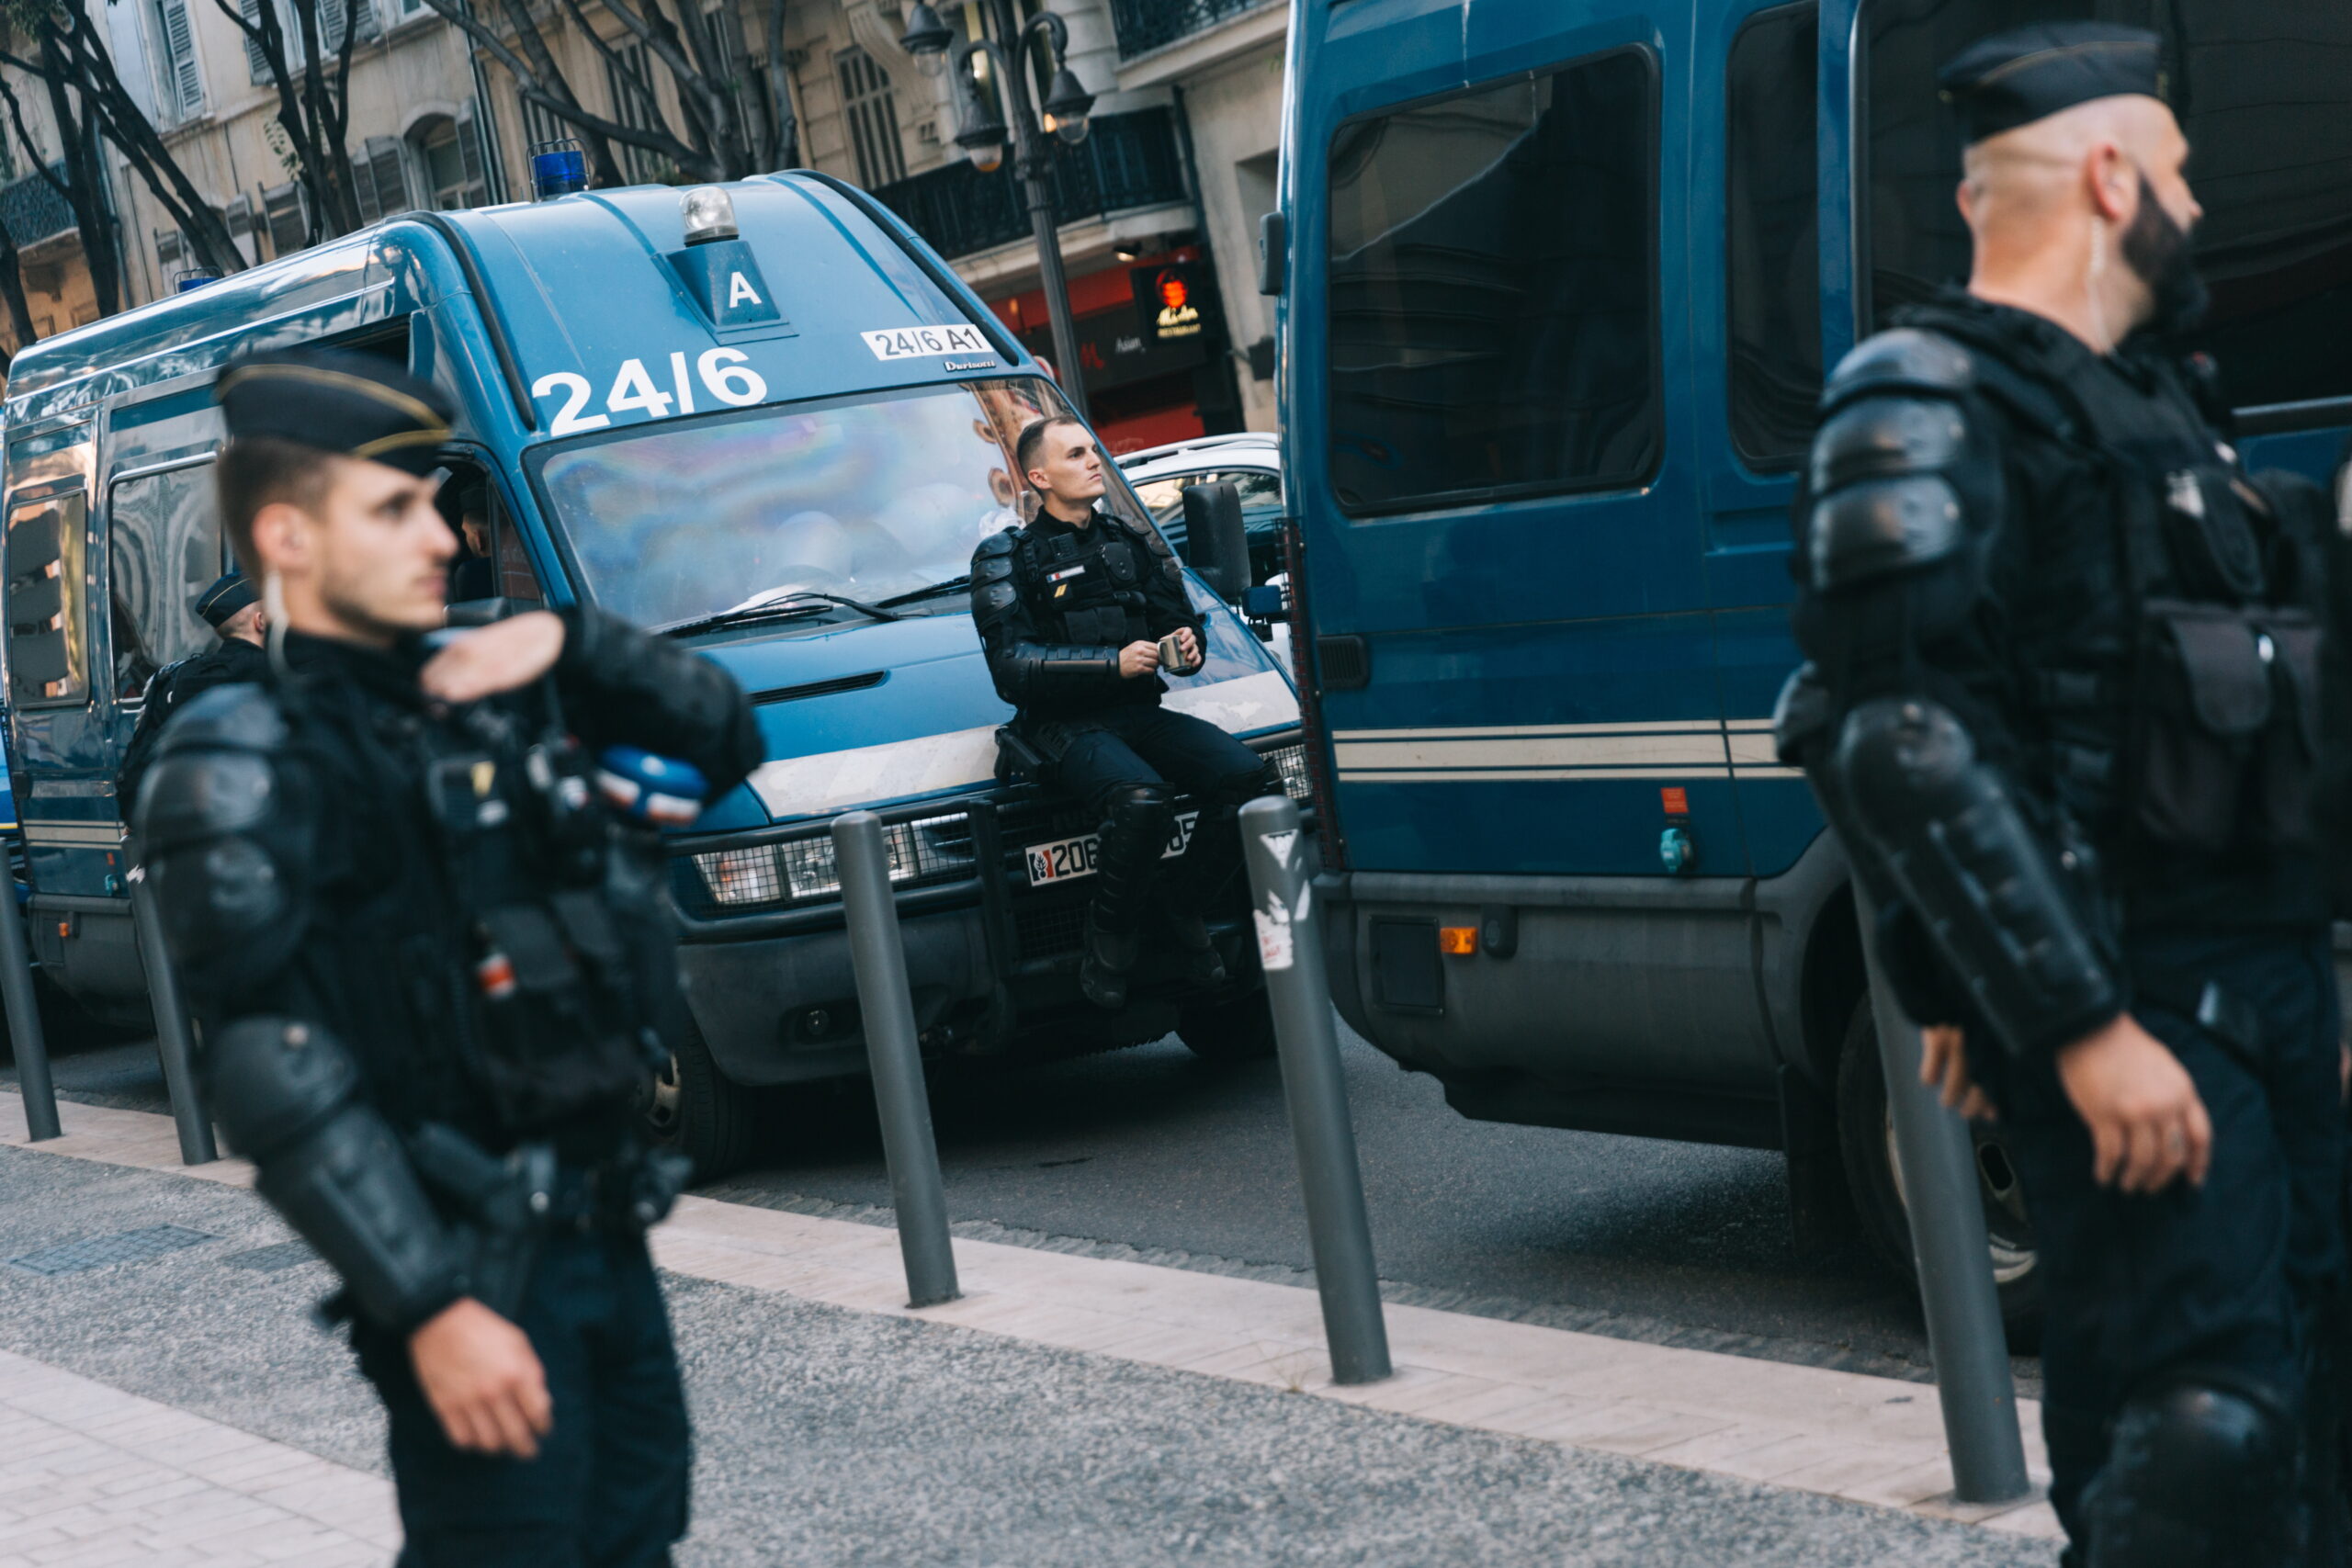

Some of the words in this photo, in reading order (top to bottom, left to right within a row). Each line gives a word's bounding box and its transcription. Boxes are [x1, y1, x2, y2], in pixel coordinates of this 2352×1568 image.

[729, 271, 762, 309] A
[875, 329, 944, 356] 24/6
[946, 327, 983, 350] A1
[531, 346, 768, 437] 24/6
